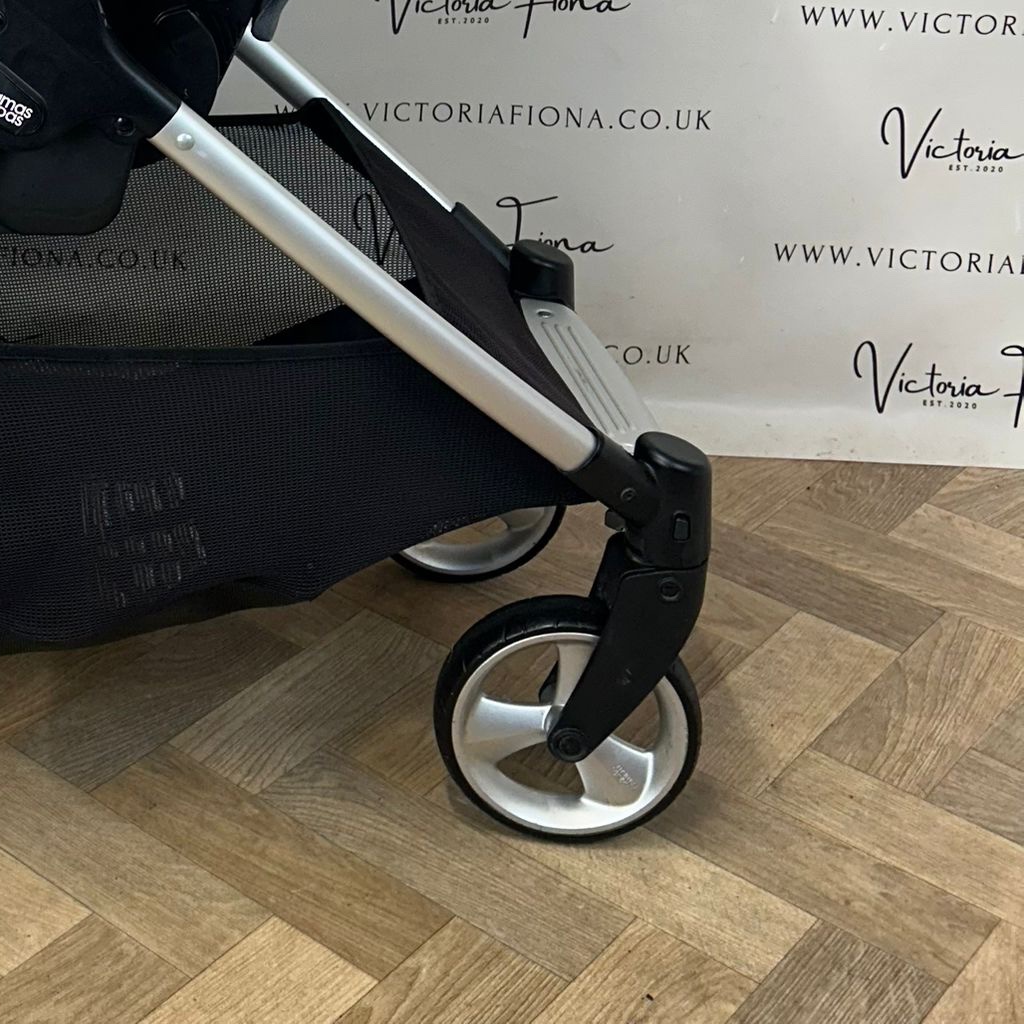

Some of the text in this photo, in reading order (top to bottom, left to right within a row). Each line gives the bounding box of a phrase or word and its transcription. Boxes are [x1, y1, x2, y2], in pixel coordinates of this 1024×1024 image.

[438, 15, 489, 24] EST.2020
[881, 106, 1024, 179] Victoria
[948, 164, 1004, 173] EST.2020
[853, 341, 1001, 414] Victoria
[923, 399, 977, 409] EST.2020
